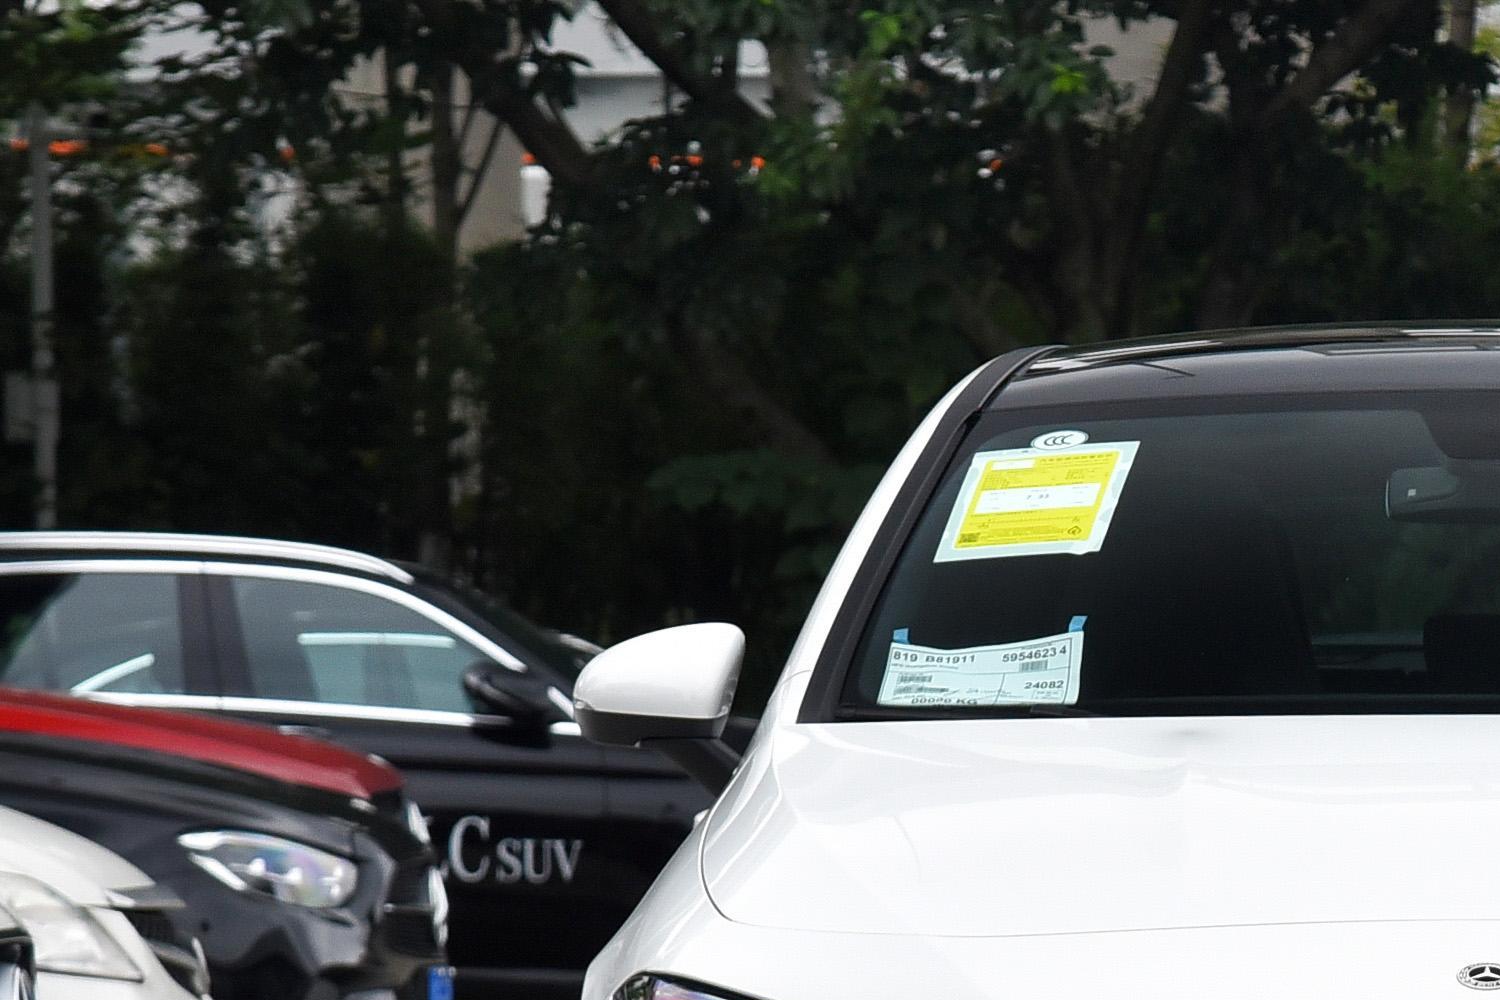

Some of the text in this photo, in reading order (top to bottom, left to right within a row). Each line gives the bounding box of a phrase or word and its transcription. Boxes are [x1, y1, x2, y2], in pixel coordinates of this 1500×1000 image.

[893, 650, 918, 662] 819
[1024, 680, 1064, 689] 24082
[495, 837, 583, 884] SUV
